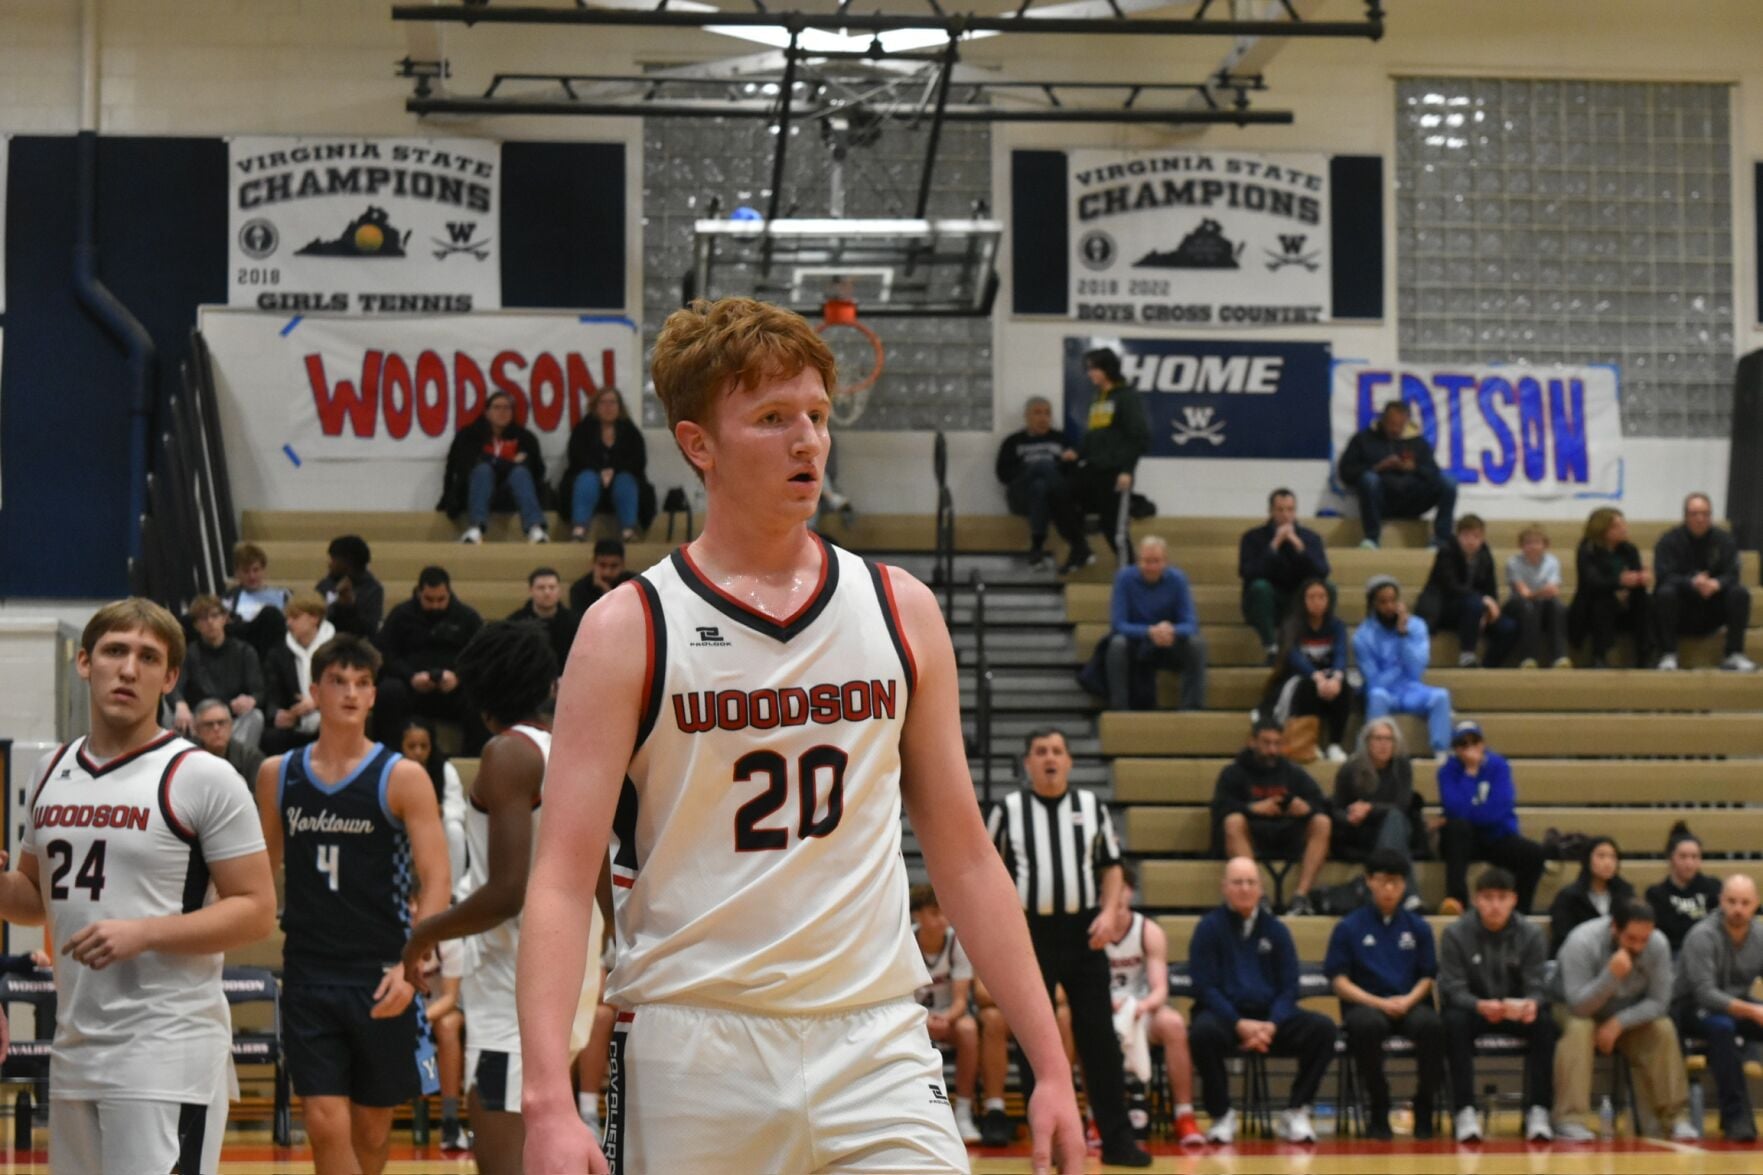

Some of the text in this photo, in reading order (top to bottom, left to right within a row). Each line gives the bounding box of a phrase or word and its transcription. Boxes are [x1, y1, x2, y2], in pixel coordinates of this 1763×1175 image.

[237, 144, 493, 178] VIRGINIA STATE
[1076, 155, 1322, 191] VIRGINIA STATE
[238, 166, 491, 214] CHAMPIONS
[1078, 179, 1320, 225] CHAMPIONS
[446, 221, 476, 243] W
[1277, 234, 1307, 254] W
[238, 268, 280, 285] 2018
[1077, 279, 1170, 296] 2018 2022
[257, 292, 473, 312] GIRLS TENNIS
[1077, 303, 1134, 322] BOYS
[1142, 304, 1211, 322] CROSS
[1120, 355, 1284, 394] HOME
[304, 349, 615, 440] WOODSON
[1182, 406, 1214, 428] W
[672, 679, 896, 734] WOODSON
[732, 744, 848, 853] 20
[34, 804, 150, 831] WOODSON
[286, 807, 375, 837] Yorktown
[46, 838, 107, 902] 24
[316, 844, 340, 892] 4
[422, 1057, 436, 1080] Y
